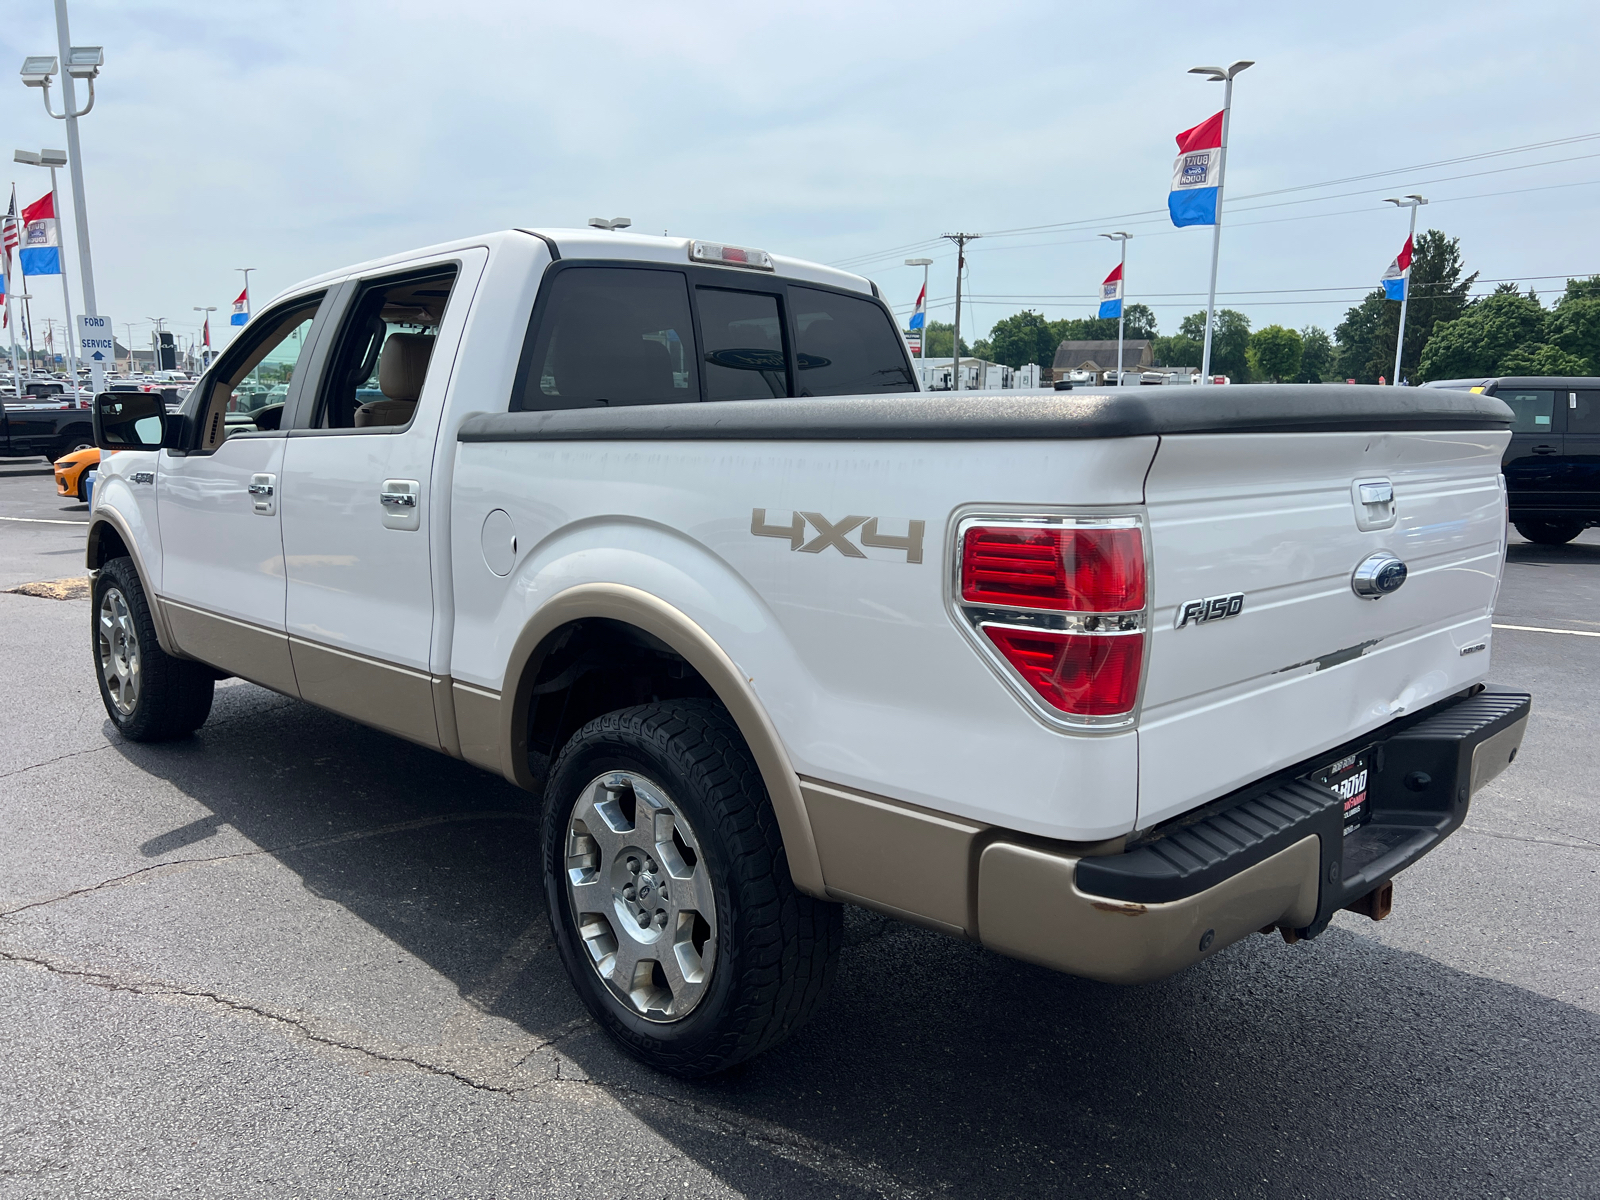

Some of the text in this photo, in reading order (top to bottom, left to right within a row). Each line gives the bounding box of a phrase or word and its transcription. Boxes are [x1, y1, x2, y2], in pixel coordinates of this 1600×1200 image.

[84, 317, 104, 326] FORD
[82, 339, 112, 348] SERVICE
[751, 508, 926, 564] 4X4
[1174, 592, 1245, 630] F-150
